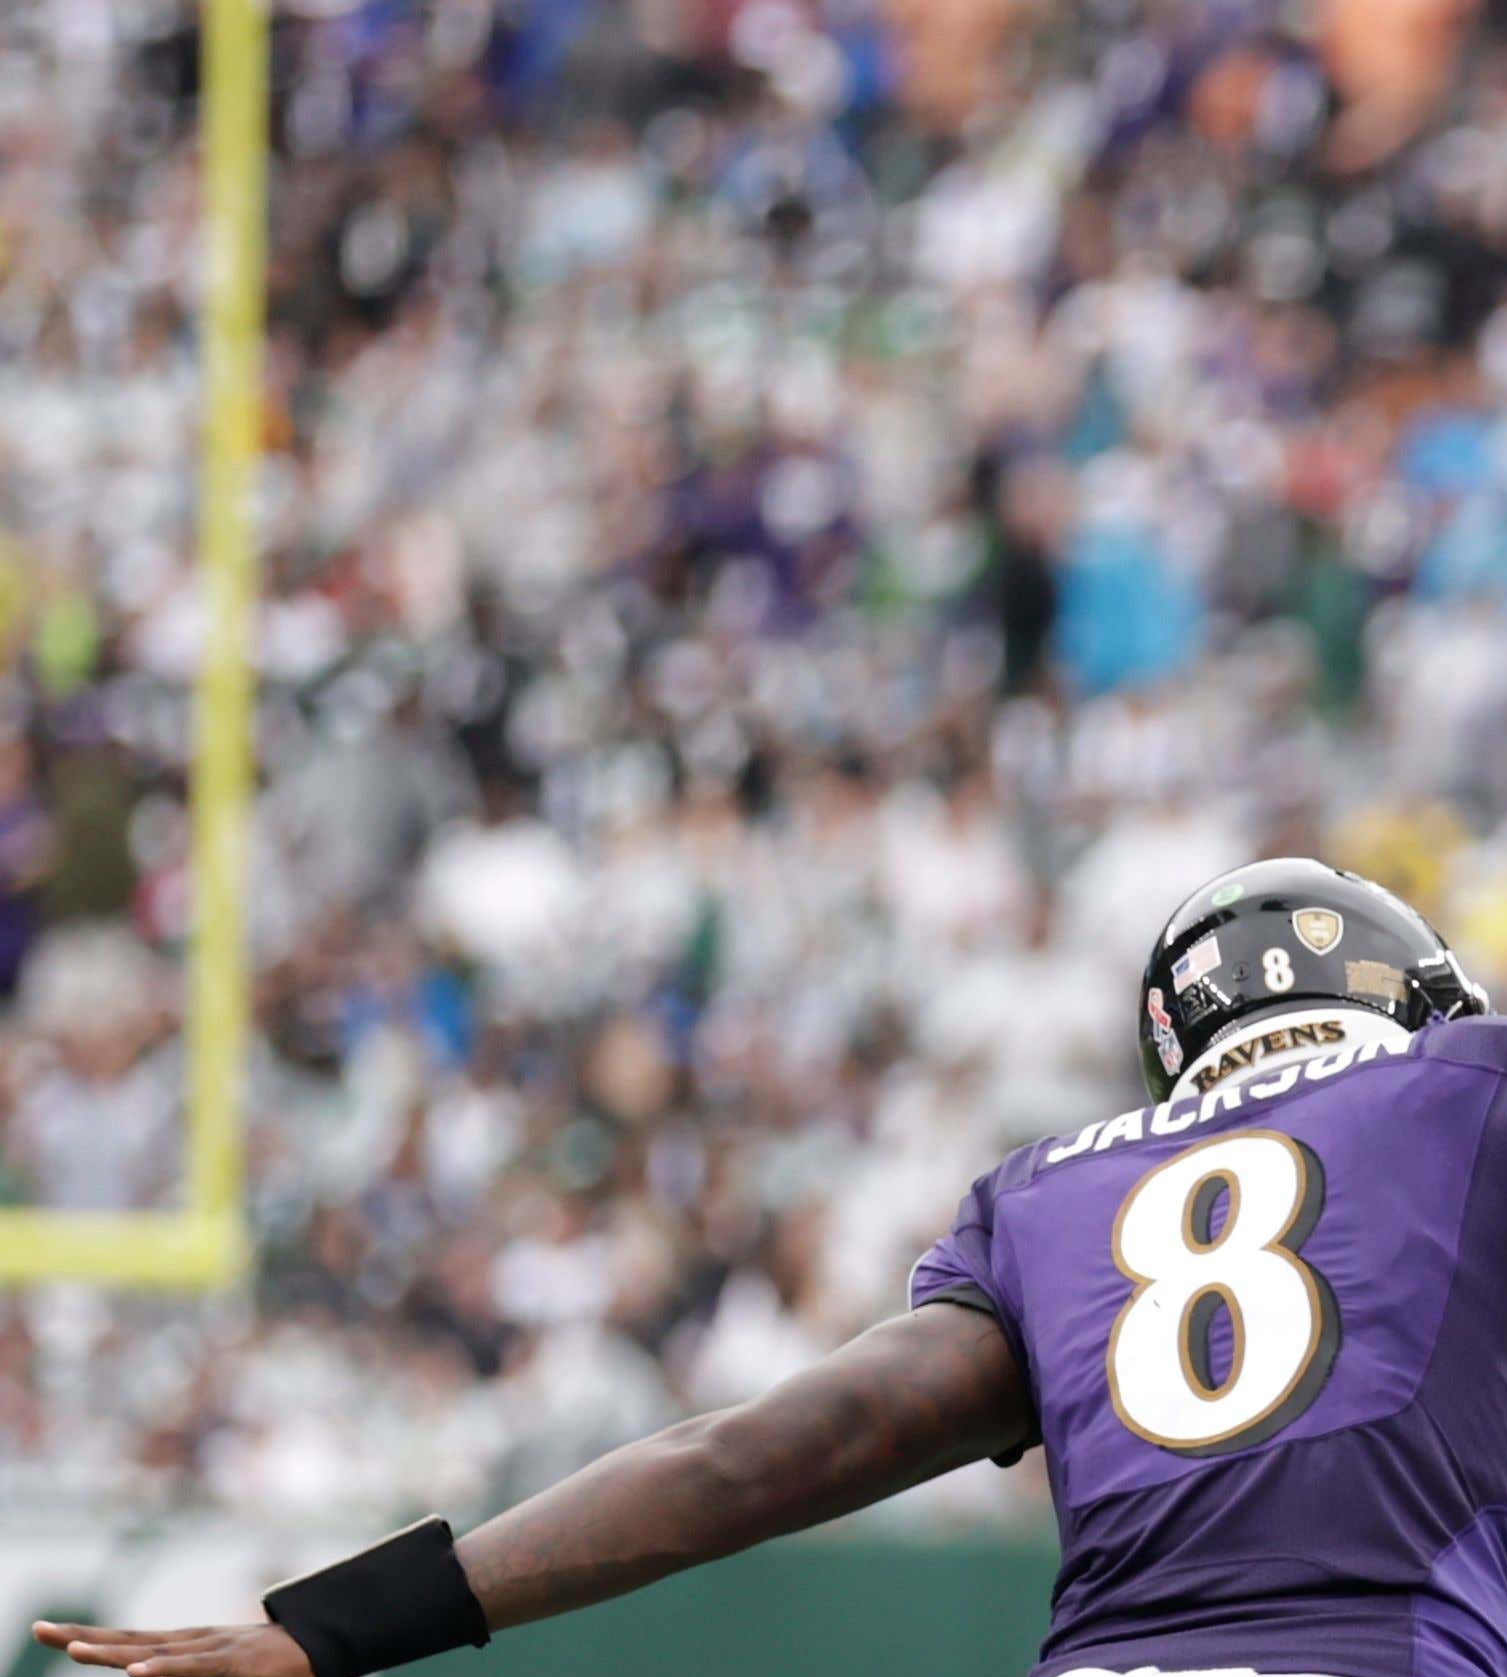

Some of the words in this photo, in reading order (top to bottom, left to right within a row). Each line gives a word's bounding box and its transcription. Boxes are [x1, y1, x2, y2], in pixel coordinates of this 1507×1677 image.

[1262, 947, 1295, 993] 8
[1190, 1020, 1346, 1094] RAVENS
[1106, 1128, 1335, 1455] 8
